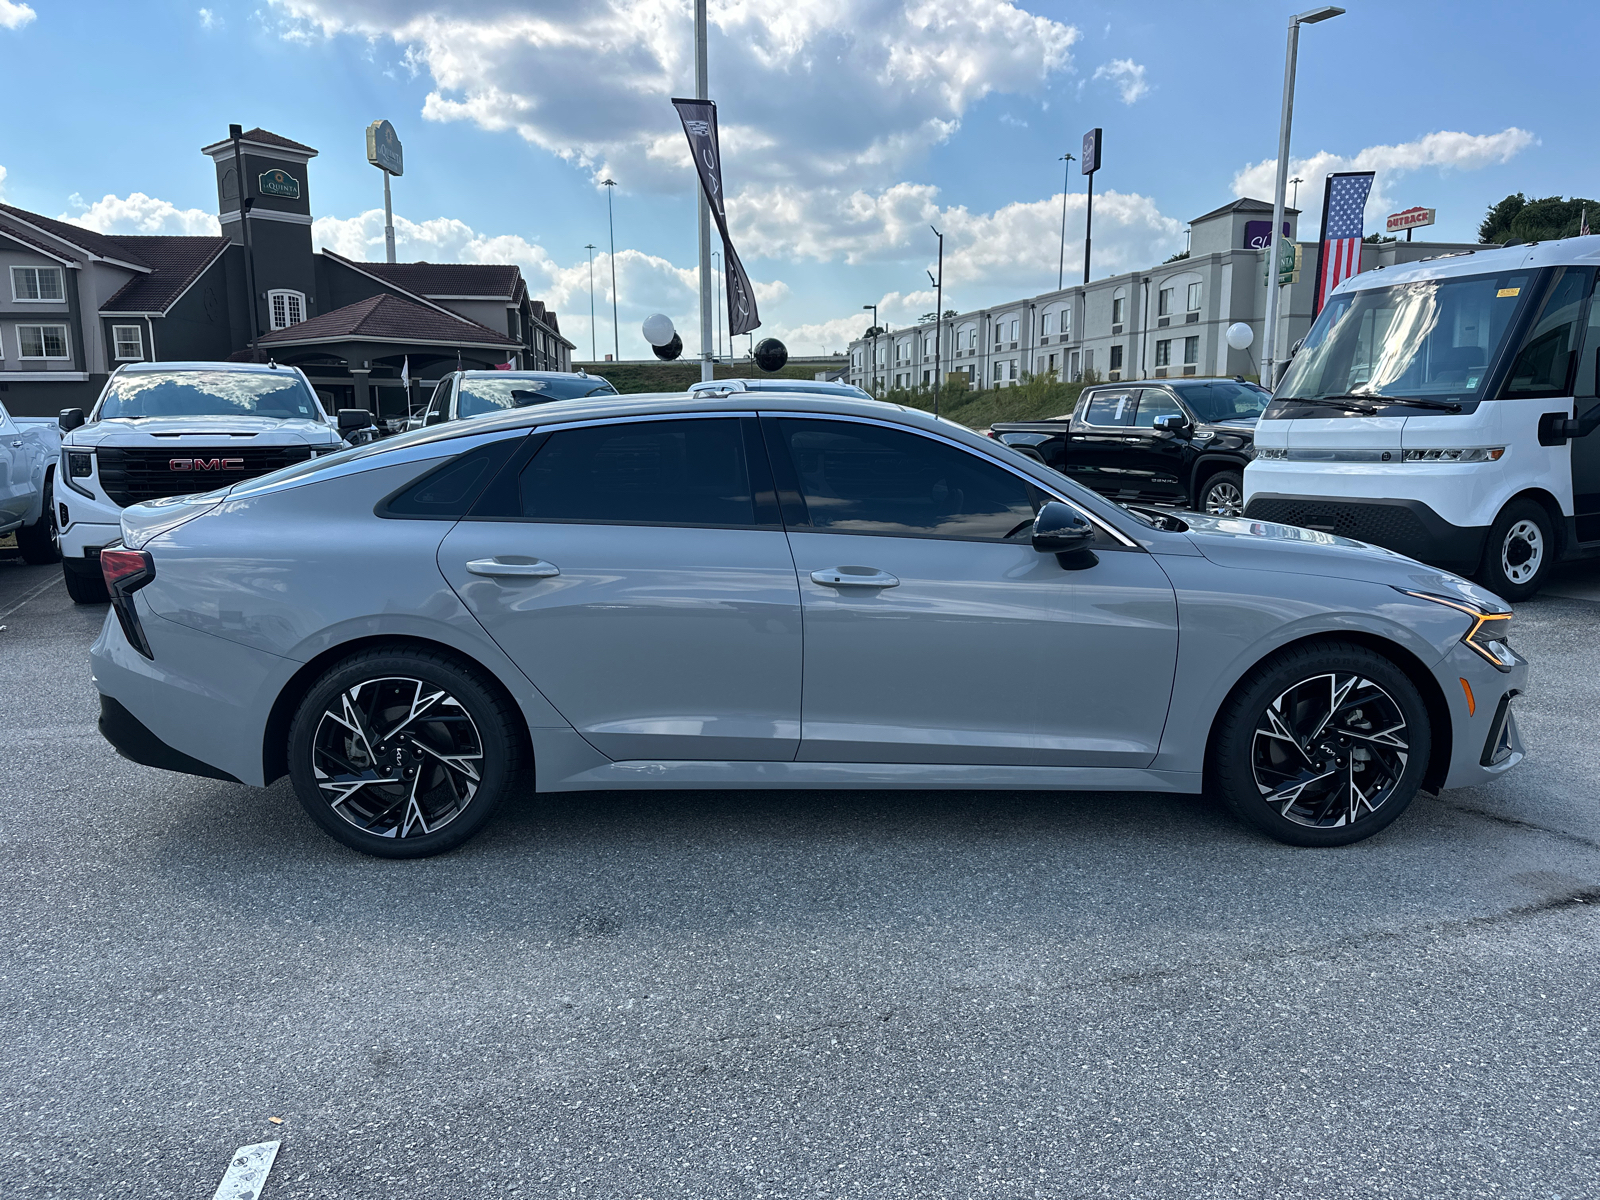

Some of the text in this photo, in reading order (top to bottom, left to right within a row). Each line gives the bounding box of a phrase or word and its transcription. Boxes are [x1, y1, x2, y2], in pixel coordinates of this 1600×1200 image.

[268, 182, 298, 193] QUINTA
[1387, 211, 1429, 228] OUTBACK
[169, 458, 245, 471] GMC
